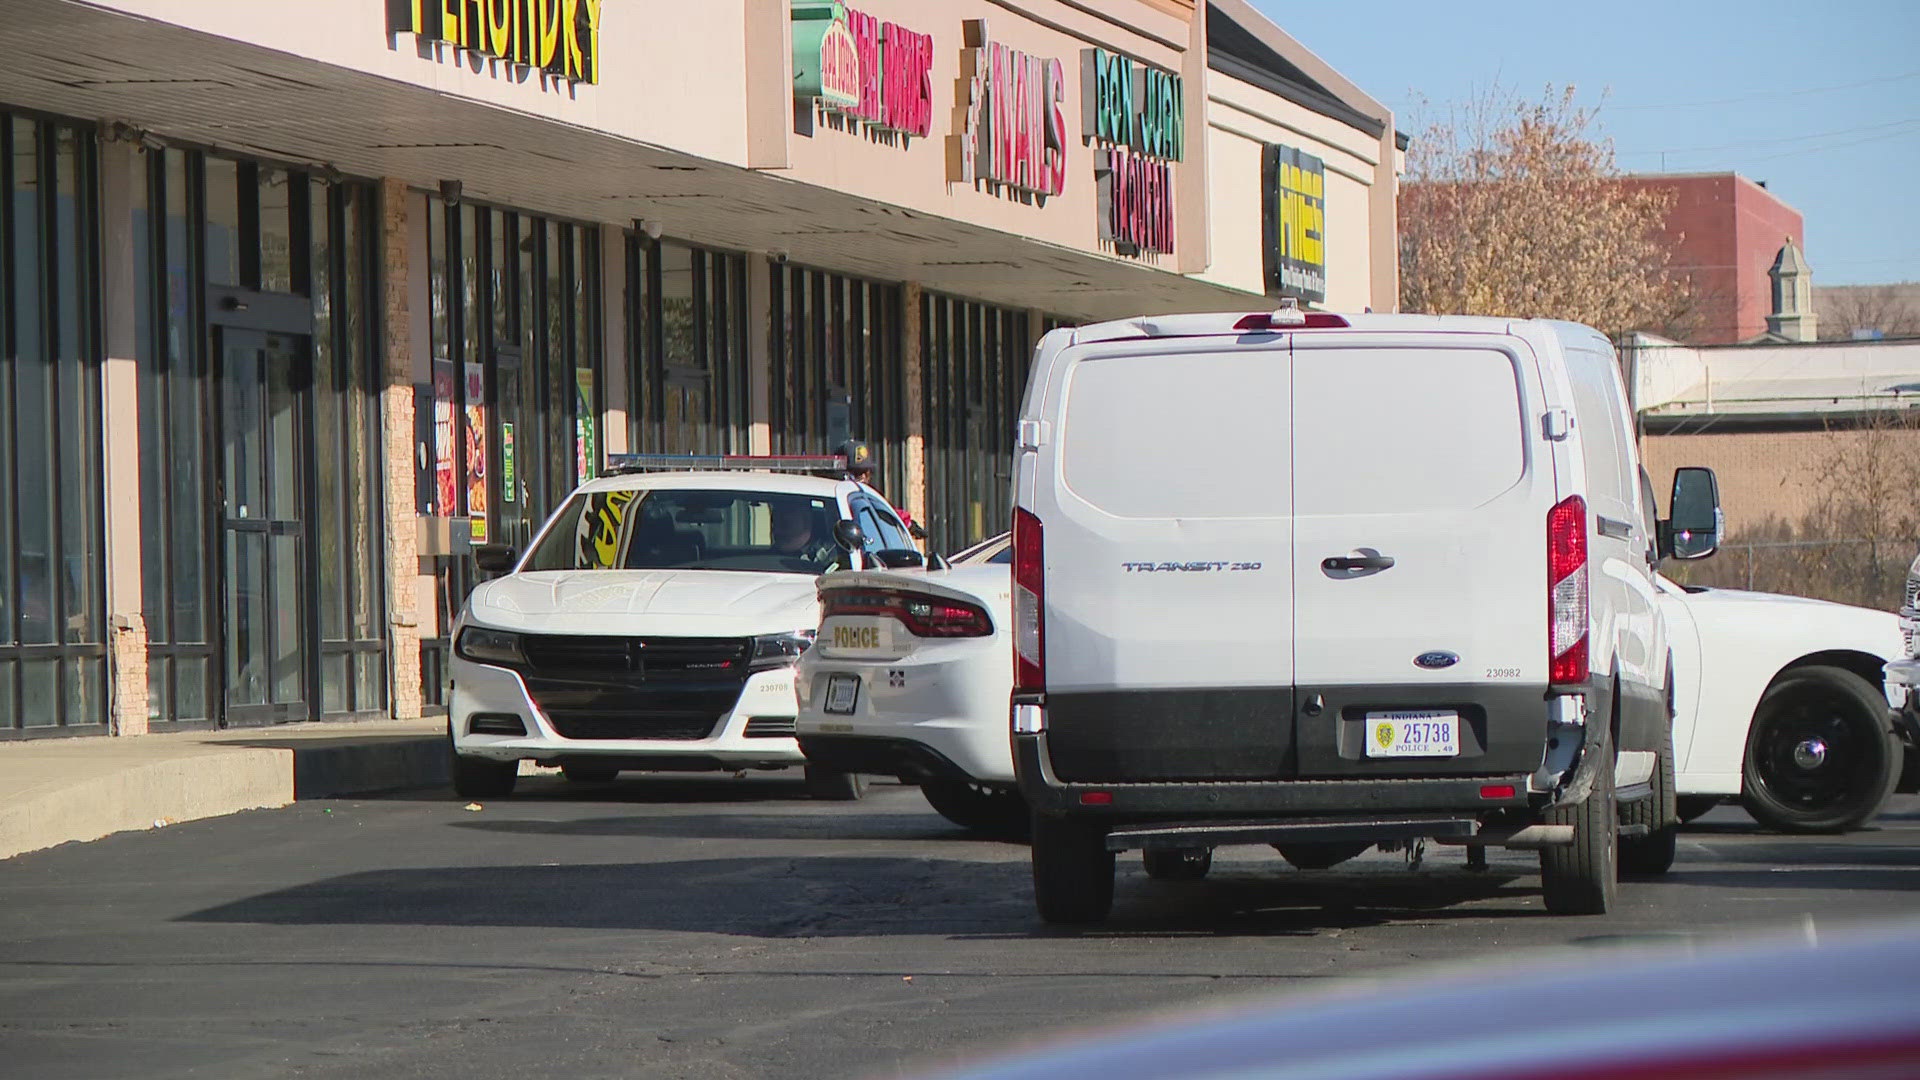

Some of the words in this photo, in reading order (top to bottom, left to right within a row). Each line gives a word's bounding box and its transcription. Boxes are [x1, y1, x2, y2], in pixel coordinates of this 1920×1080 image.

[1095, 48, 1134, 147] DON
[1140, 66, 1185, 164] JUAN
[989, 40, 1068, 197] NAILS
[1111, 147, 1174, 254] TAQUERIA
[1121, 561, 1229, 573] TRANSIT
[1230, 561, 1263, 571] 250
[834, 626, 881, 649] POLICE
[1486, 668, 1521, 678] 230982
[1391, 713, 1432, 721] INDIANA
[1403, 723, 1451, 744] 25738
[1395, 744, 1430, 752] POLICE
